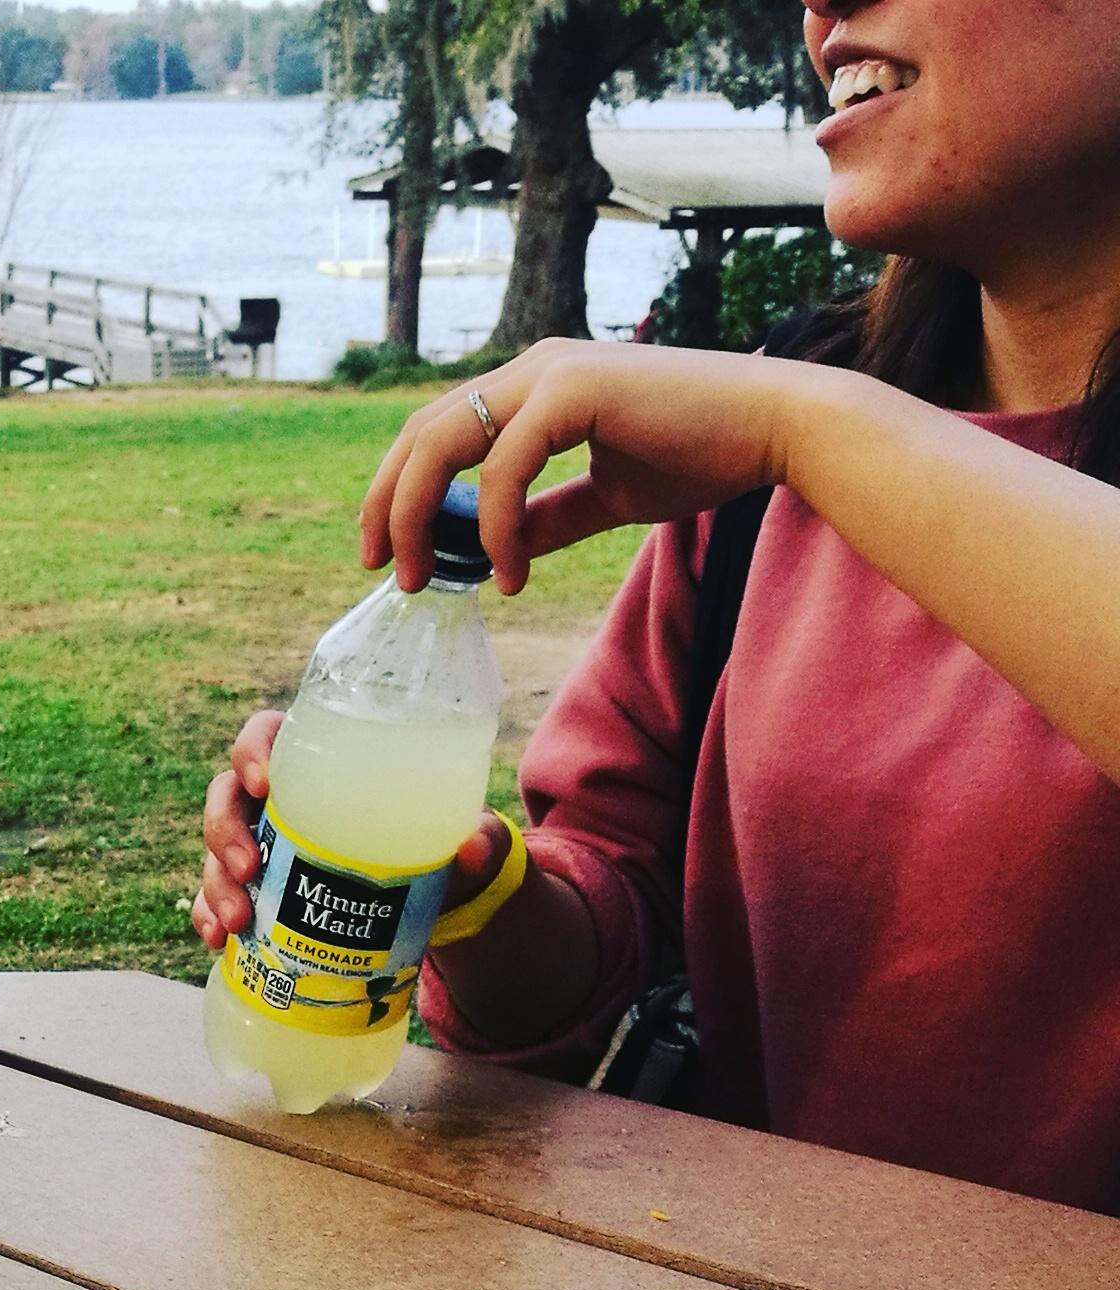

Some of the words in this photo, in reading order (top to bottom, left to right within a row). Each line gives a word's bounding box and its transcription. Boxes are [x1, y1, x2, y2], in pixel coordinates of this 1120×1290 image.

[295, 873, 393, 918] Minute
[301, 902, 373, 939] Maid
[286, 936, 373, 967] LEMONADE
[268, 973, 292, 994] 260
